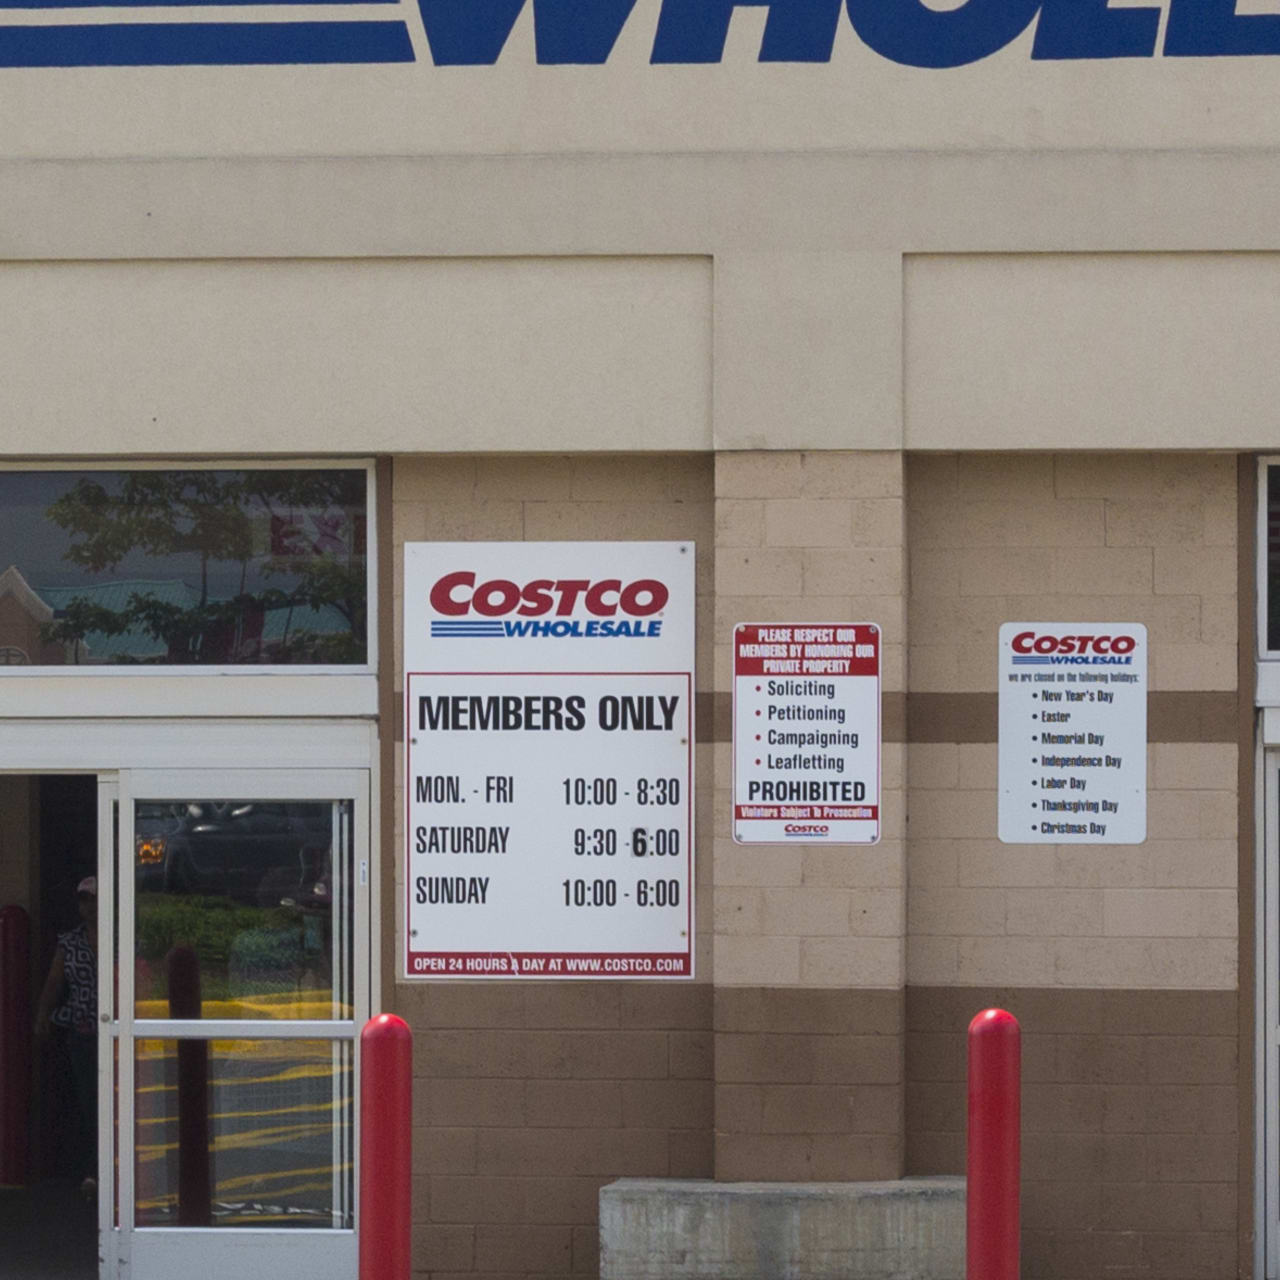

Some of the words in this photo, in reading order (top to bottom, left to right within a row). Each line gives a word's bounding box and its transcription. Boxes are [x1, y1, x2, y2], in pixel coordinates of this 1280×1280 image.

[429, 570, 670, 617] COSTCO
[504, 620, 662, 637] WHOLESALE
[758, 629, 792, 642] PLEASE
[794, 629, 834, 642] RESPECT
[837, 629, 855, 642] OUR
[1012, 632, 1136, 654] COSTCO
[740, 645, 787, 657] MEMBERS
[790, 645, 803, 657] BY
[856, 645, 874, 657] OUR
[763, 660, 800, 672] PRIVATE
[803, 660, 850, 672] PROPERTY
[1050, 656, 1132, 664] WHOLESALE
[768, 680, 834, 699] Soliciting
[1042, 690, 1062, 701] New
[1066, 690, 1095, 701] Year's
[1098, 690, 1114, 703] Day
[419, 696, 585, 731] MEMBERS
[599, 696, 679, 731] ONLY
[768, 705, 845, 724] Petitioning
[1042, 712, 1070, 722] Easter
[768, 729, 858, 748] Campaigning
[1042, 733, 1085, 744] Memorial
[1088, 734, 1104, 746] Day
[768, 754, 844, 773] Leafletting
[1042, 756, 1102, 768] Independence
[1106, 756, 1122, 768] Day
[417, 776, 465, 803] MON.
[486, 776, 513, 803] FRI
[563, 778, 616, 805] 10:00
[637, 778, 679, 805] 8:30
[749, 781, 865, 801] PROHIBITED
[1042, 778, 1067, 789] Labor
[1070, 778, 1086, 790] Day
[741, 807, 778, 817] Violators
[781, 807, 810, 819] Subject
[813, 807, 821, 817] To
[824, 807, 872, 817] Prosecution
[1042, 800, 1099, 813] Thanksgiving
[1102, 800, 1118, 813] Day
[785, 824, 829, 833] COSTCO
[1042, 822, 1087, 833] Christmas
[1090, 823, 1106, 835] Day
[416, 826, 509, 853] SATURDAY
[575, 829, 616, 856] 9:30
[632, 827, 680, 858] 6:00
[416, 877, 489, 904] SUNDAY
[563, 879, 616, 906] 10:00
[637, 880, 679, 907] 6:00
[414, 958, 445, 970] OPEN
[449, 958, 463, 970] 24
[467, 958, 508, 971] HOURS
[510, 956, 519, 973] A
[523, 959, 545, 970] DAY
[549, 959, 562, 970] AT
[566, 959, 683, 971] WWW.COSTCO.COM
